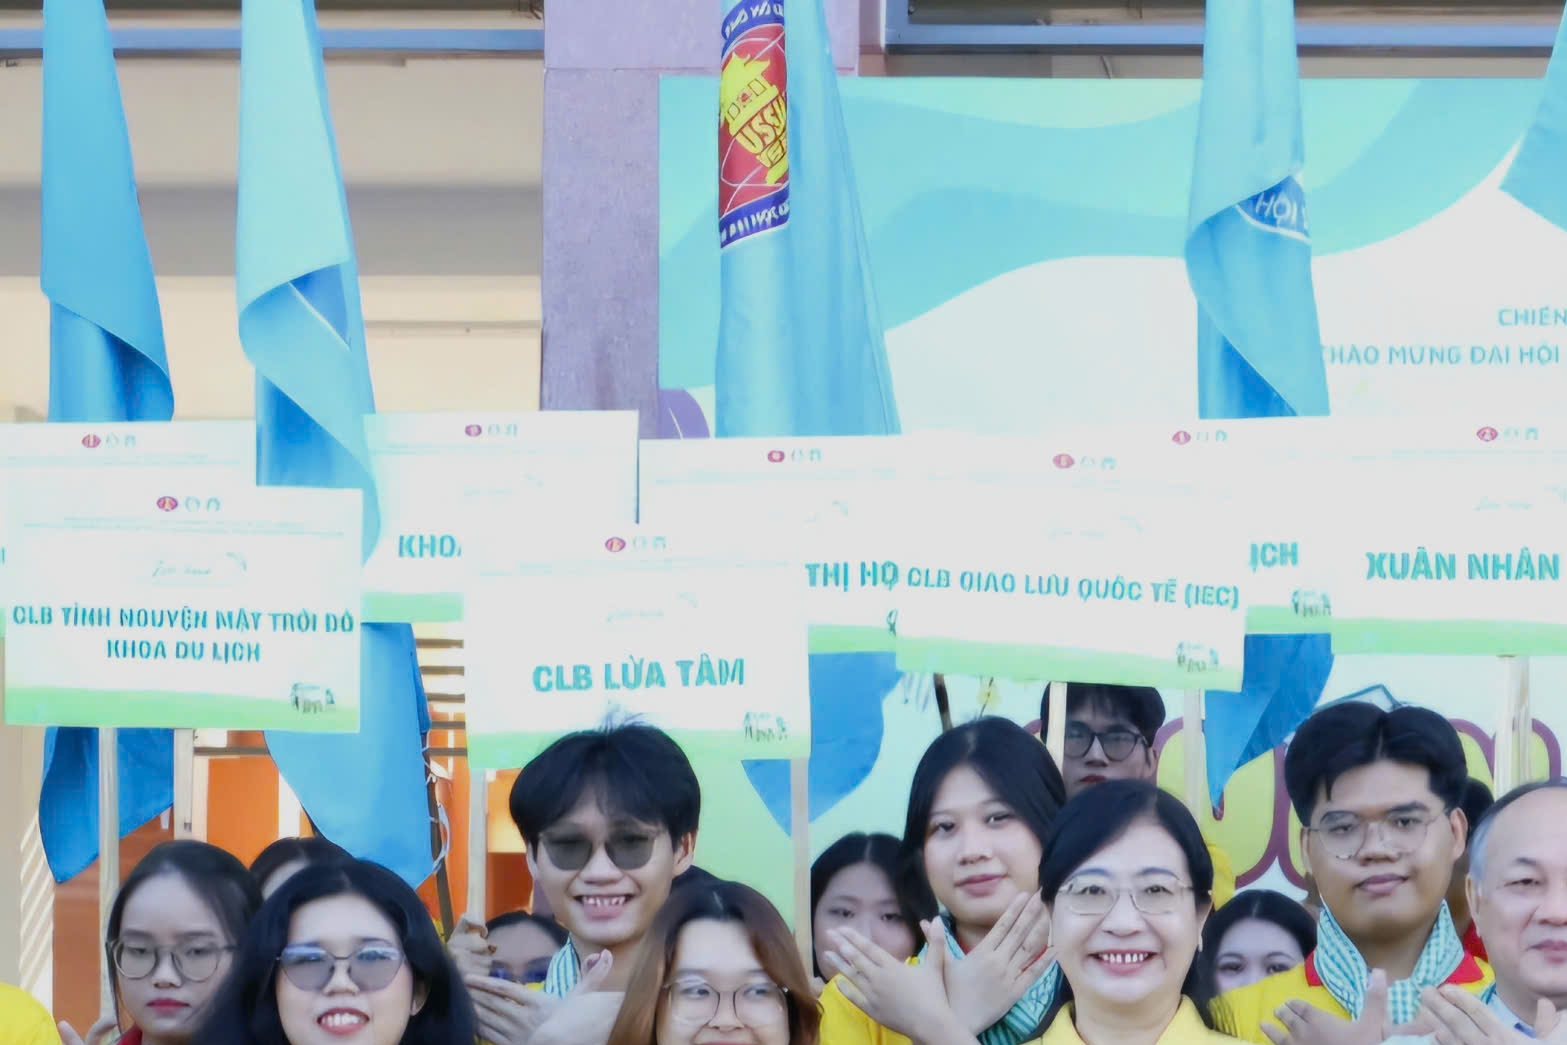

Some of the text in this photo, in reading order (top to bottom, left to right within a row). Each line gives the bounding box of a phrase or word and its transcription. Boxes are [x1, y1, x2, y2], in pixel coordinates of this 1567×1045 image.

[1248, 541, 1299, 573] ỊCH
[1365, 546, 1457, 581] XUÂN
[1467, 546, 1560, 581] NHÂN
[859, 560, 900, 591] HỌ
[1184, 583, 1240, 611] (IEC)
[107, 639, 167, 660] KHOA
[175, 640, 205, 661] DU
[532, 663, 593, 693] CLB
